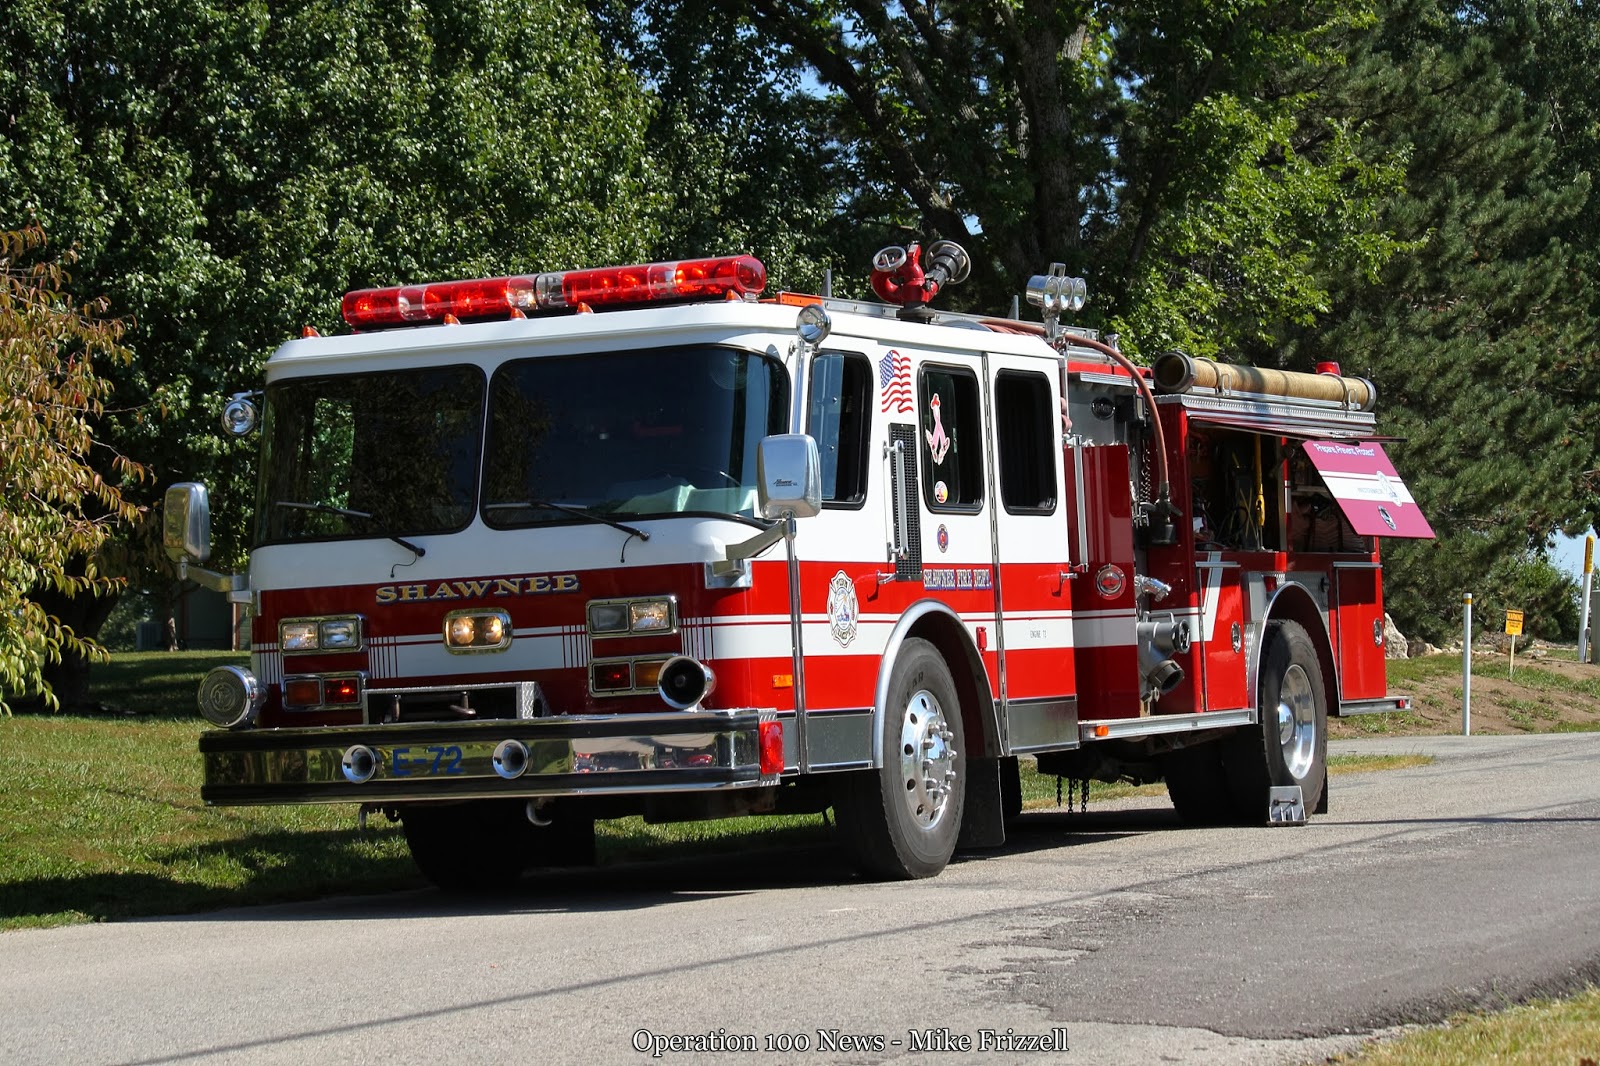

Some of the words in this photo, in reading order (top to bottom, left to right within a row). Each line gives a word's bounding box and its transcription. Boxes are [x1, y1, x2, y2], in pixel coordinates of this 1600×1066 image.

[375, 574, 580, 605] SHAWNEE
[923, 569, 956, 590] SHAWNEE
[956, 569, 973, 590] FIRE
[392, 745, 464, 776] E-72
